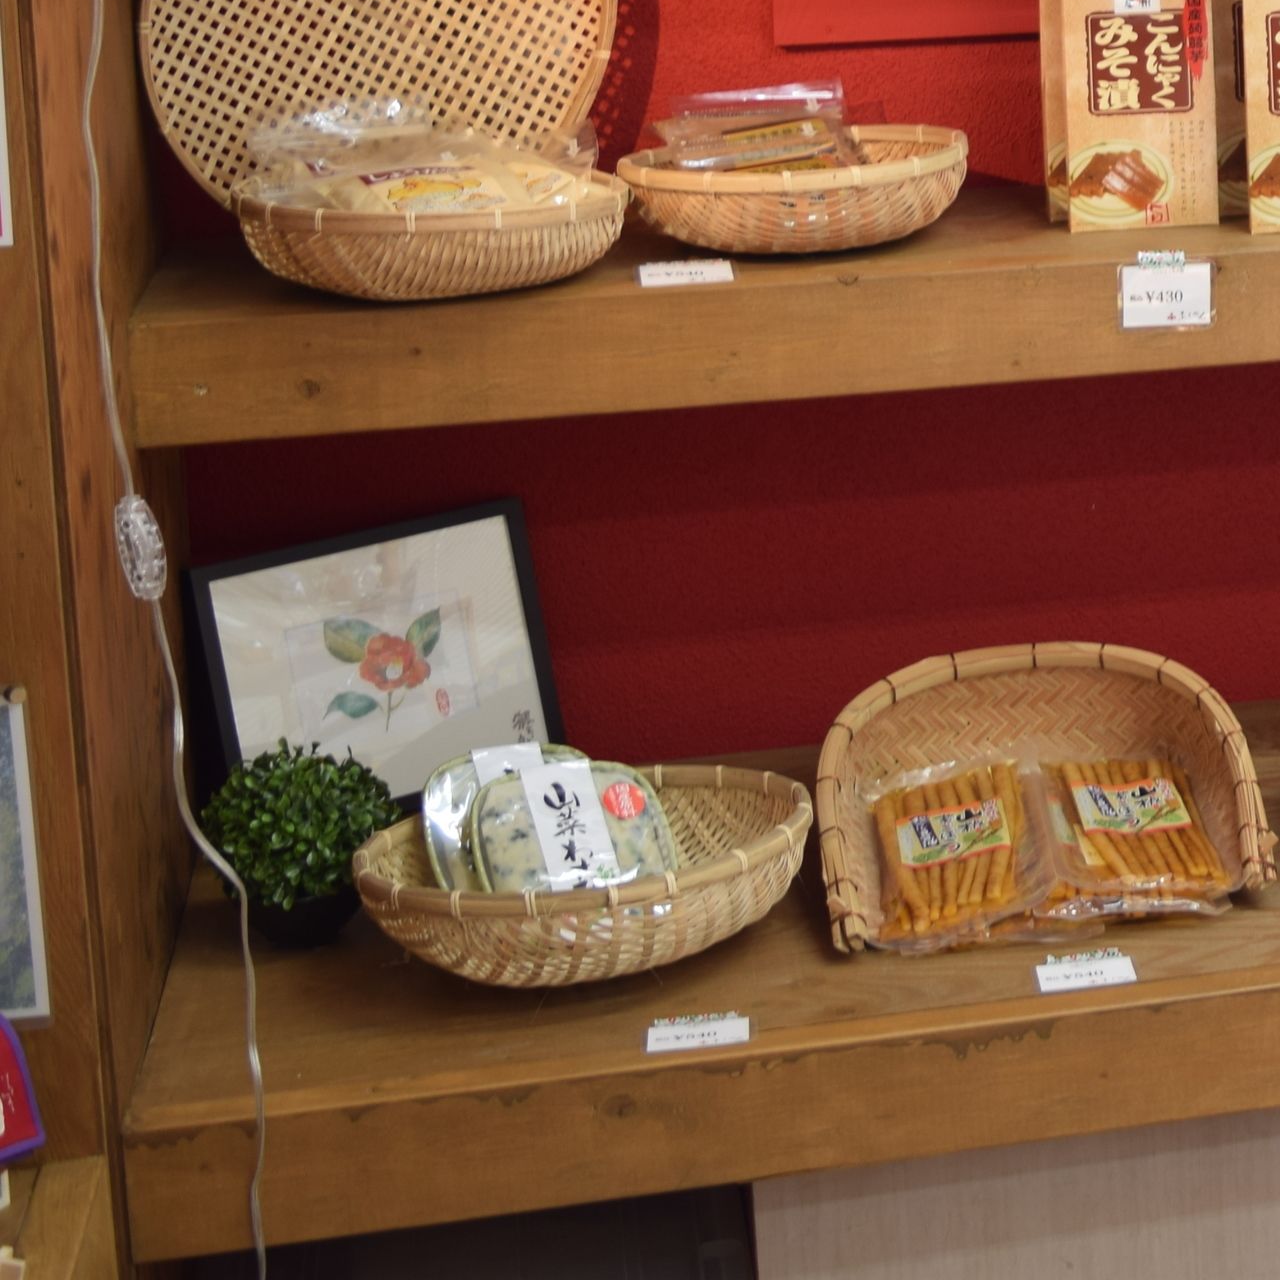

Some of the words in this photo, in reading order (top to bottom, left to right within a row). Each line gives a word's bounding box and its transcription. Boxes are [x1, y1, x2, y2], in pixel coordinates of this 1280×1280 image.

[1095, 17, 1141, 111] みそ漬
[1145, 289, 1185, 304] ¥430
